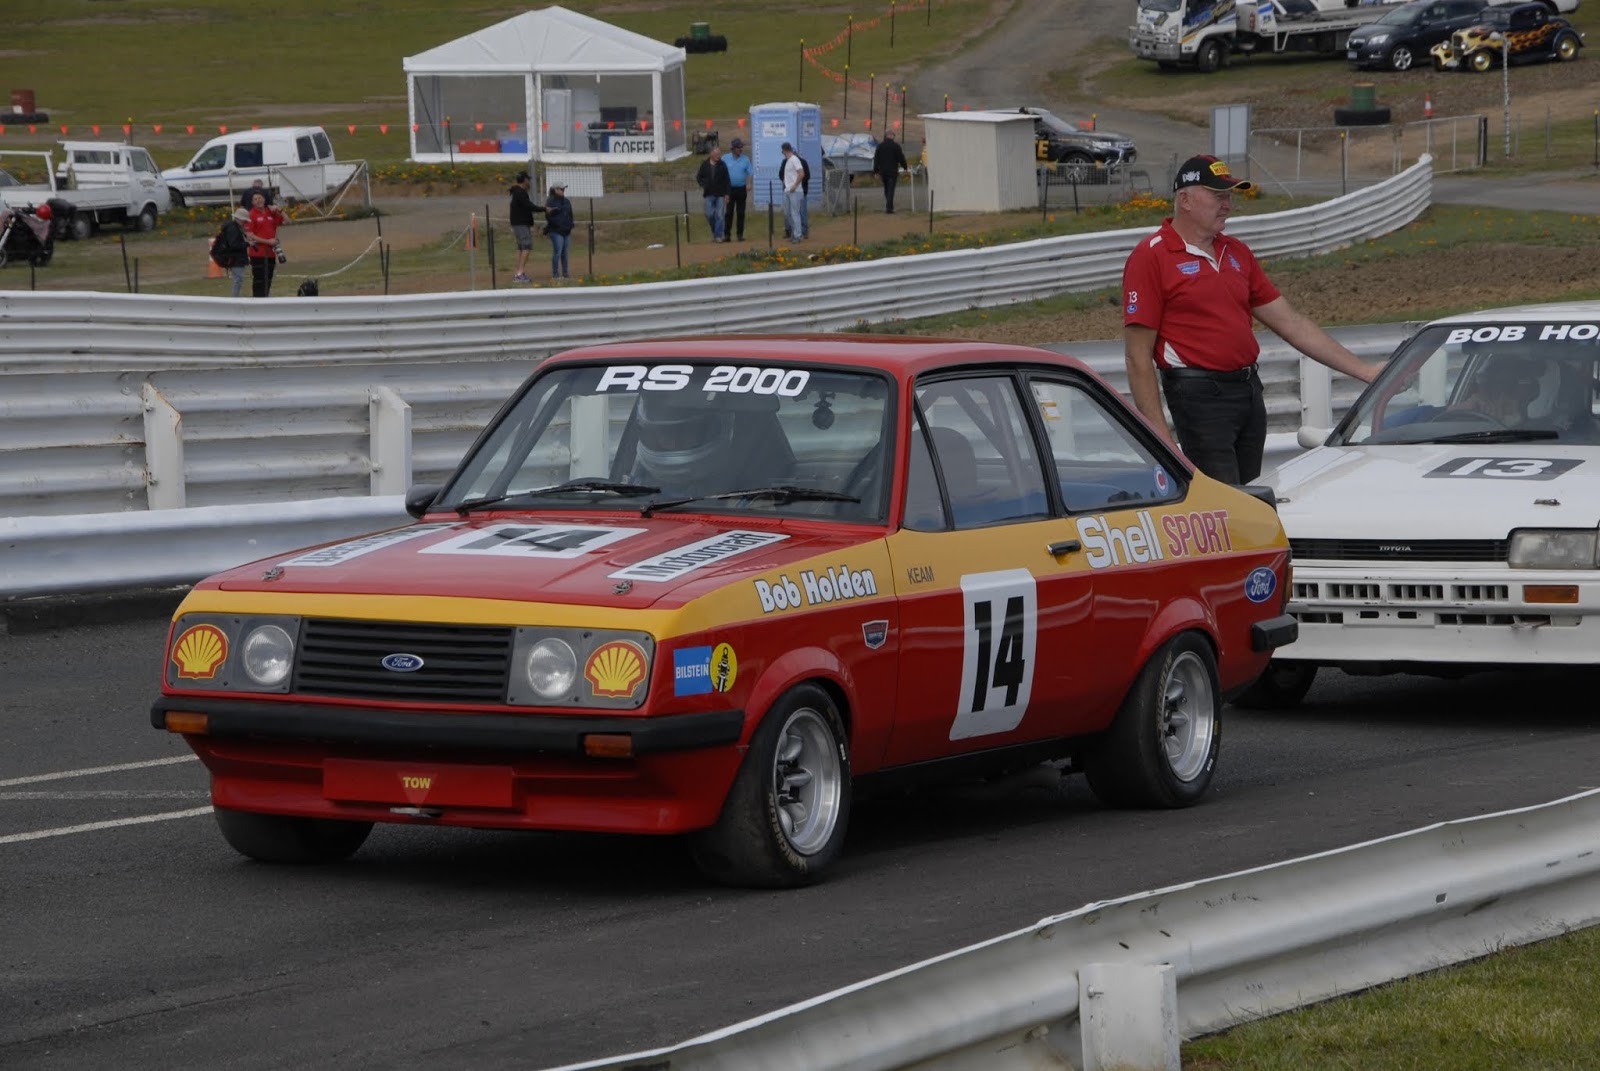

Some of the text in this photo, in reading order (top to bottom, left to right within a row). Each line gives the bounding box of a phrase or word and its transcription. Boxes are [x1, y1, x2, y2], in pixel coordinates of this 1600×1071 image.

[1128, 291, 1138, 304] 13
[1445, 324, 1600, 345] BOB HO
[595, 364, 810, 397] RS 2000
[1448, 458, 1553, 477] 13
[1075, 509, 1233, 569] Shell SPORT
[624, 532, 777, 578] Motorcraft
[906, 566, 935, 585] KEAM
[753, 564, 878, 614] Bob Holden
[391, 656, 414, 668] Ford
[971, 595, 1026, 713] 14
[675, 663, 709, 680] BILSTEIN
[402, 776, 431, 789] TOW
